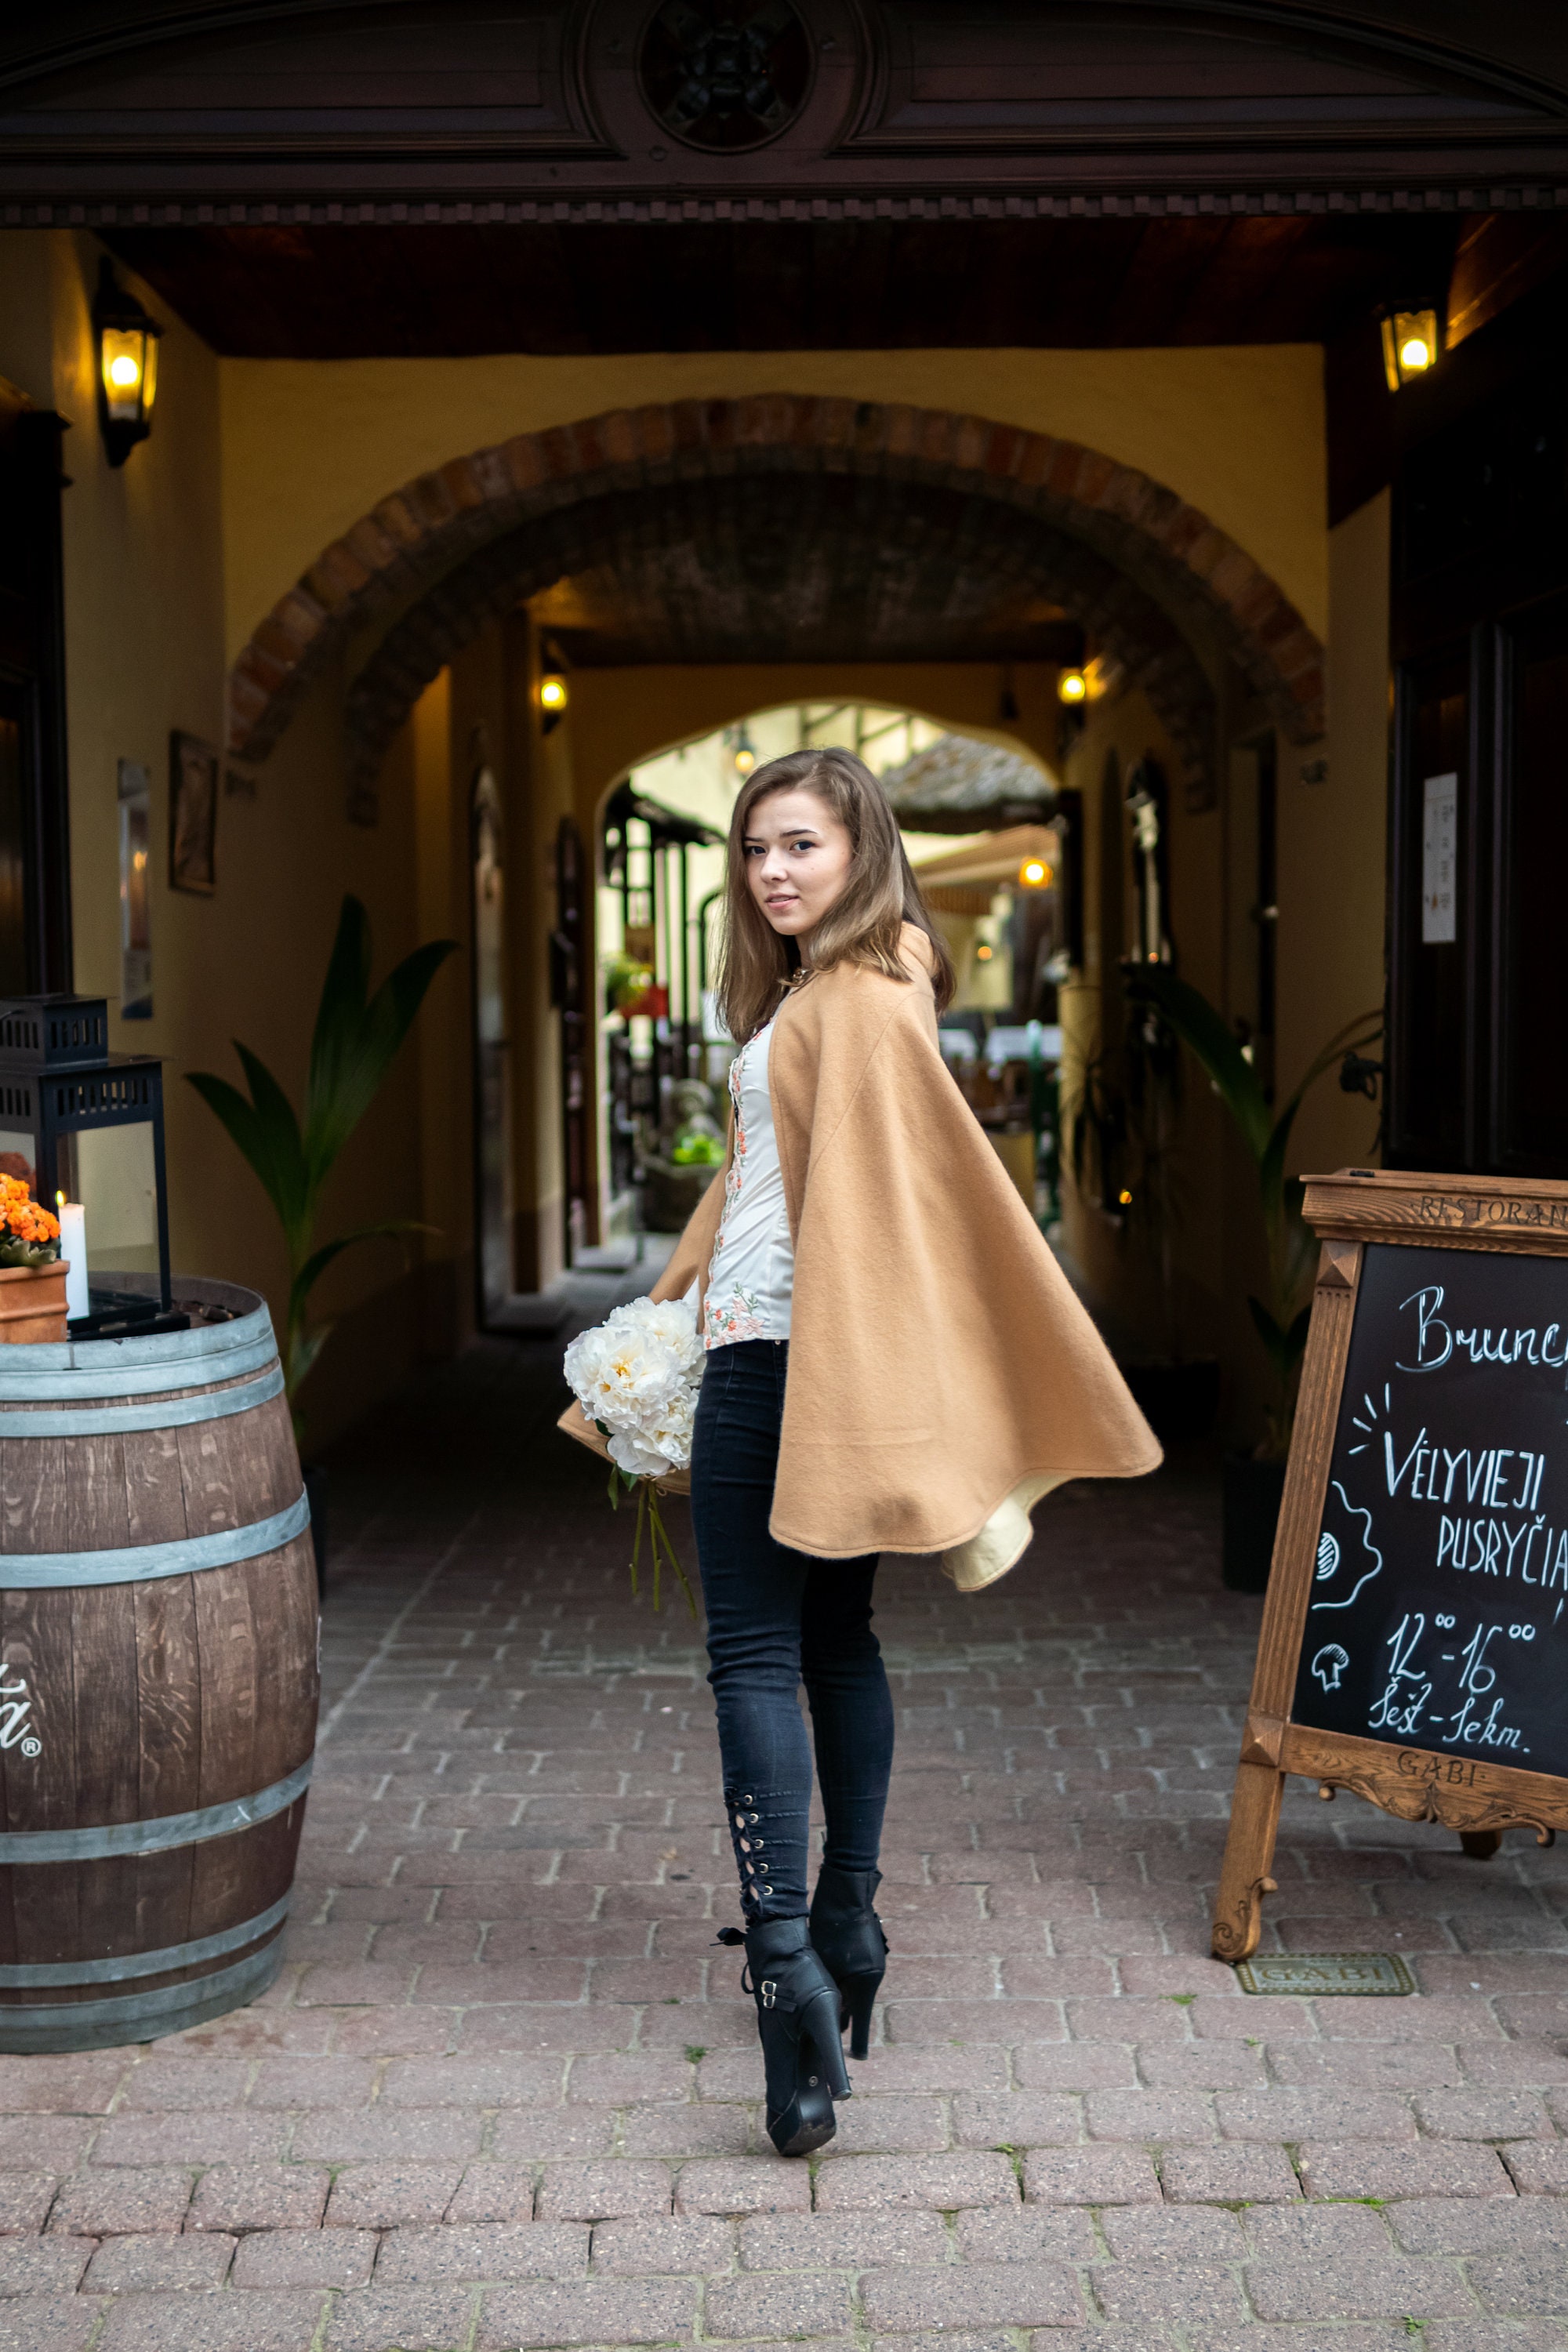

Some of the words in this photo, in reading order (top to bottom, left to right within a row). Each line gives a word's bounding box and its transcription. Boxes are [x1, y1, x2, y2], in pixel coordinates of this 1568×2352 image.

[1396, 1286, 1568, 1373] Brunc
[1384, 1427, 1544, 1512] VĖLYVIEJI
[1436, 1514, 1568, 1592] PUSRYČIA
[1397, 1750, 1477, 1788] GABI
[1261, 1966, 1384, 1981] GABI
